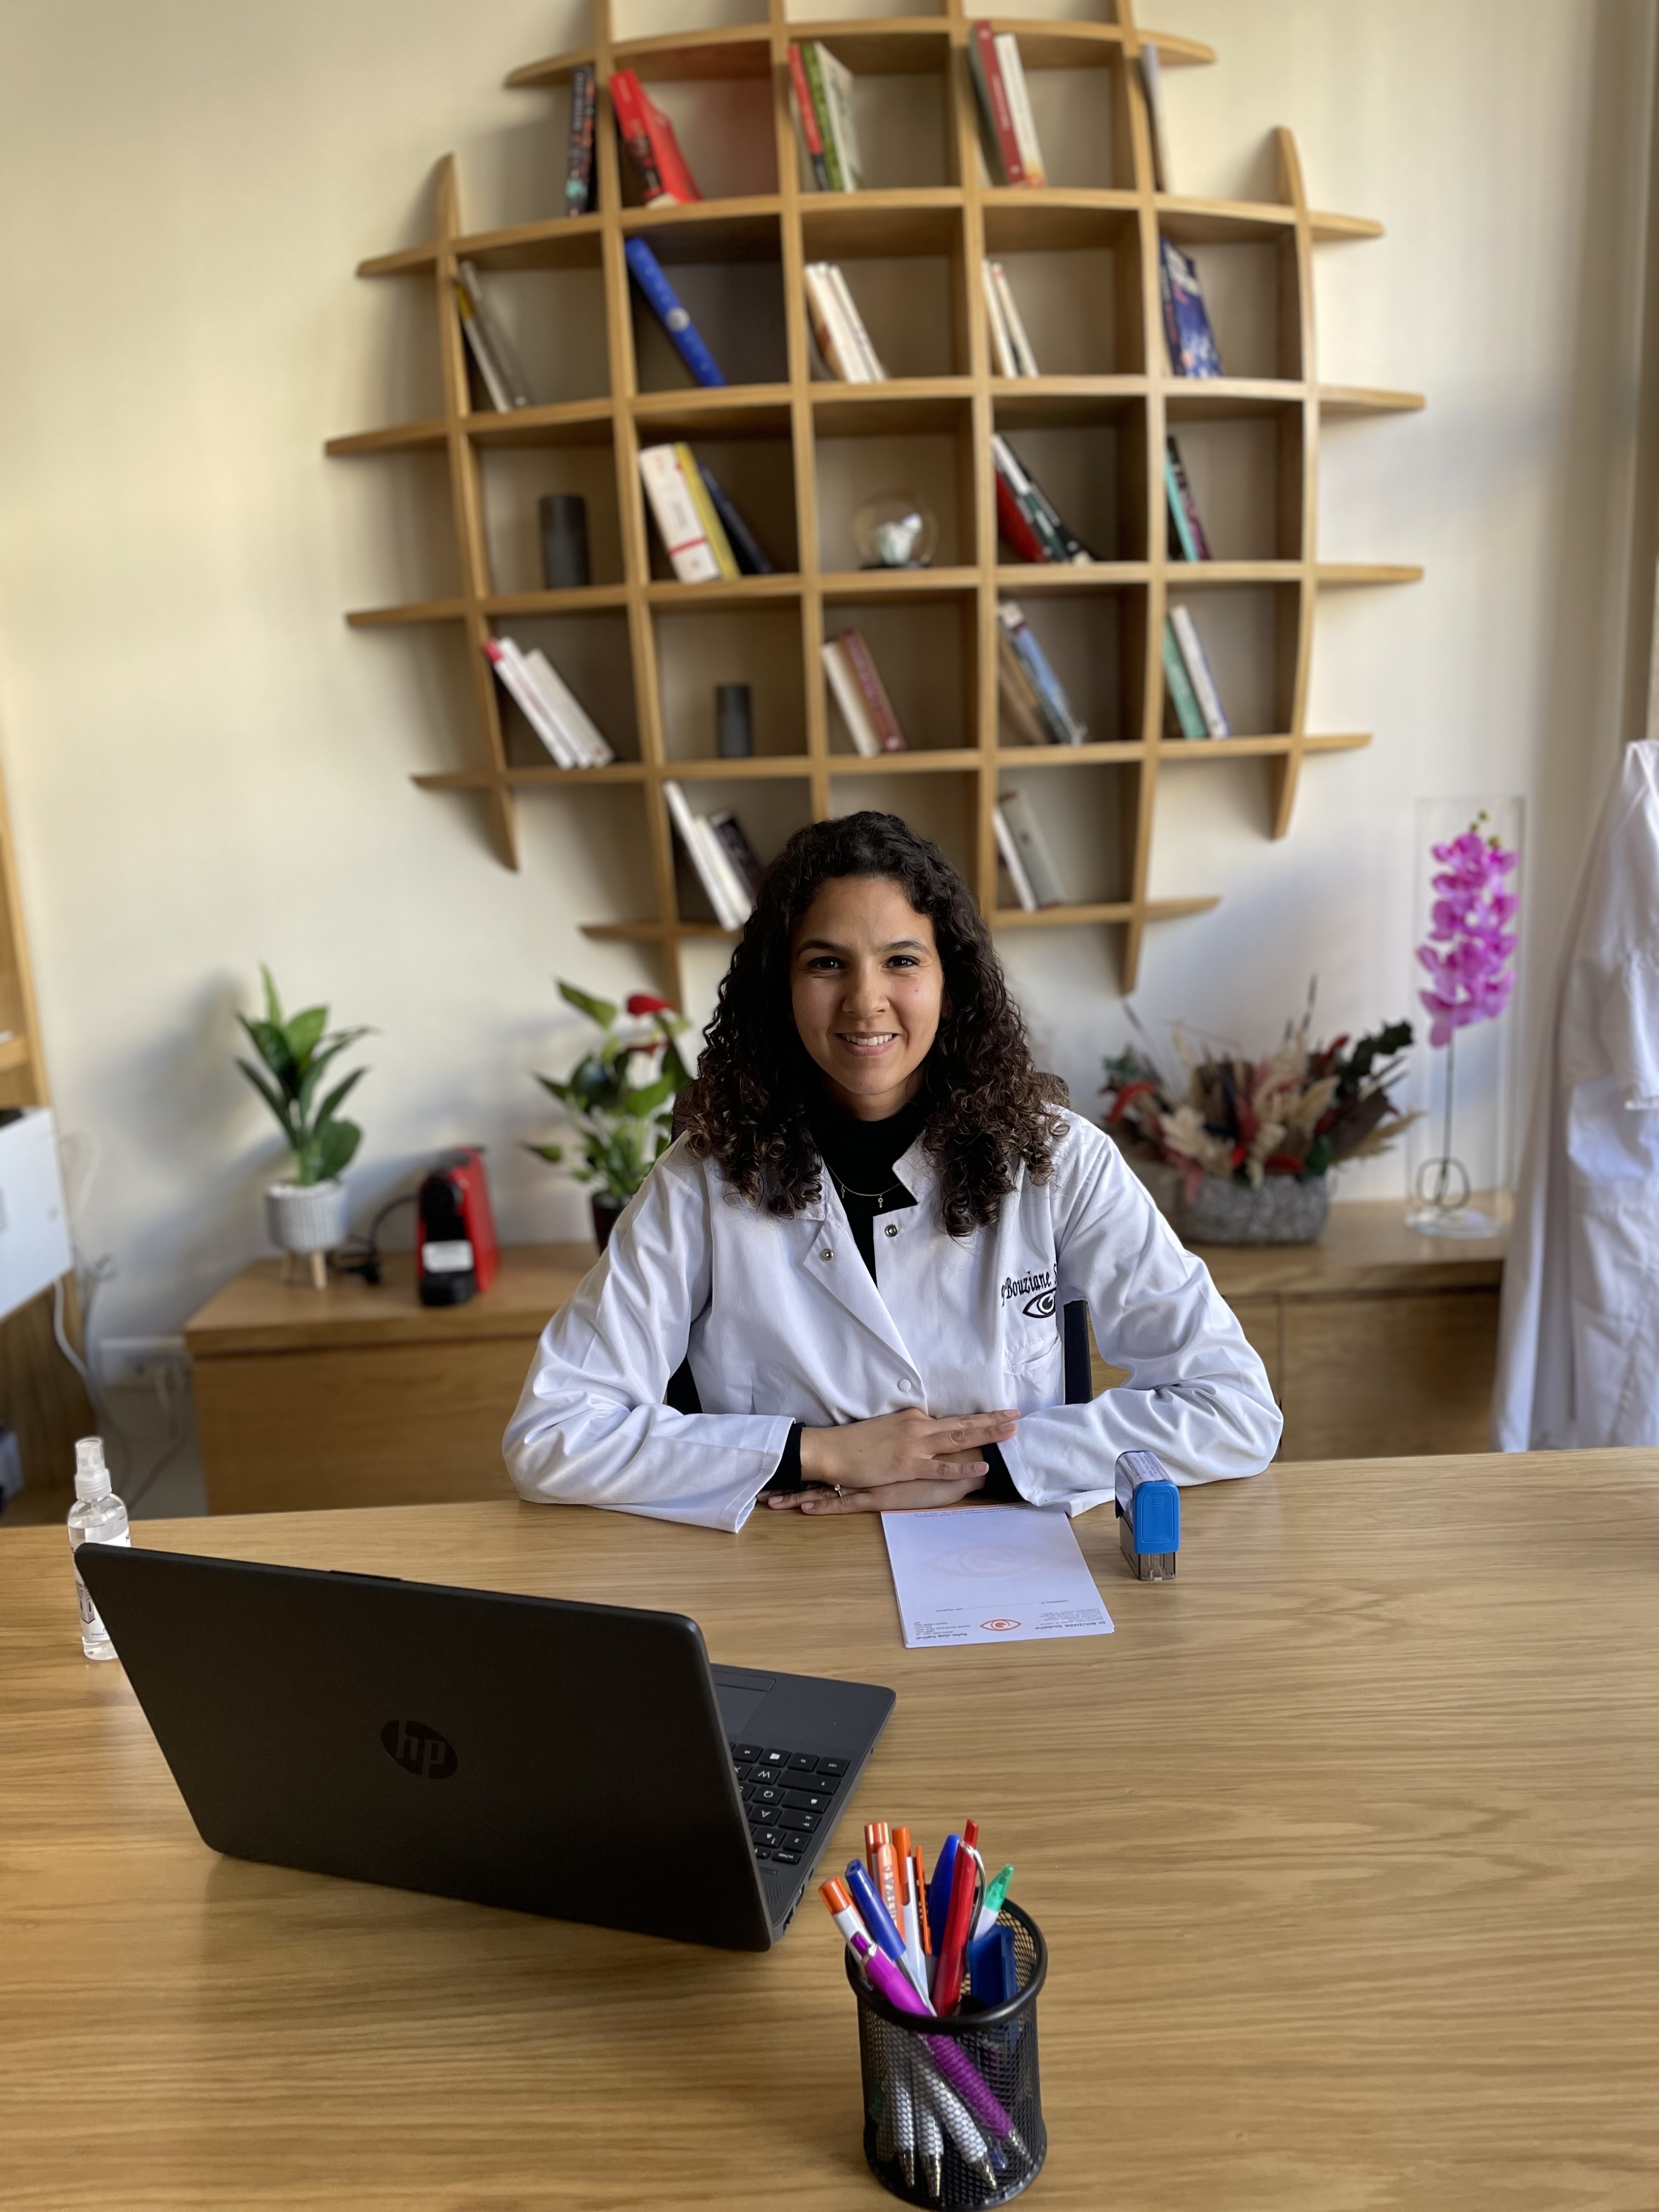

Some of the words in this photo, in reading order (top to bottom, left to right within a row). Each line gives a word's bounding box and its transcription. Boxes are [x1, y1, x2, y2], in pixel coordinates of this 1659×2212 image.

[1005, 1271, 1052, 1299] Bouziane
[394, 1720, 447, 1776] hp
[758, 1770, 770, 1779] W
